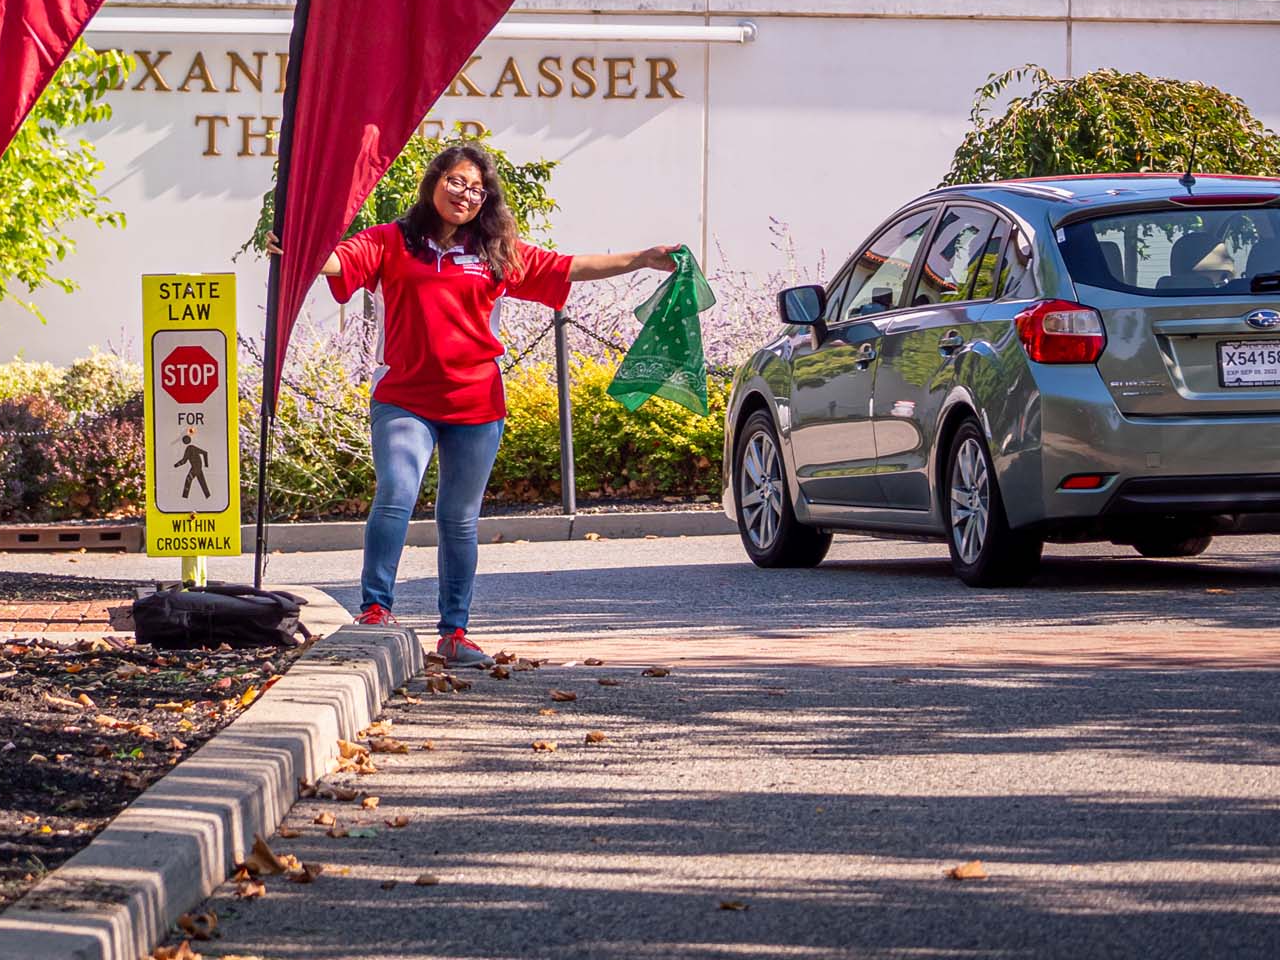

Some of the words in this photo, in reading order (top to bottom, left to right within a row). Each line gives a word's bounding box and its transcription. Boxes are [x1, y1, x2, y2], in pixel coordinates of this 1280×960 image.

[444, 56, 685, 99] KASSER
[159, 282, 220, 299] STATE
[169, 304, 211, 321] LAW
[164, 363, 216, 386] STOP
[178, 413, 204, 425] FOR
[172, 519, 216, 533] WITHIN
[157, 536, 231, 551] CROSSWALK
